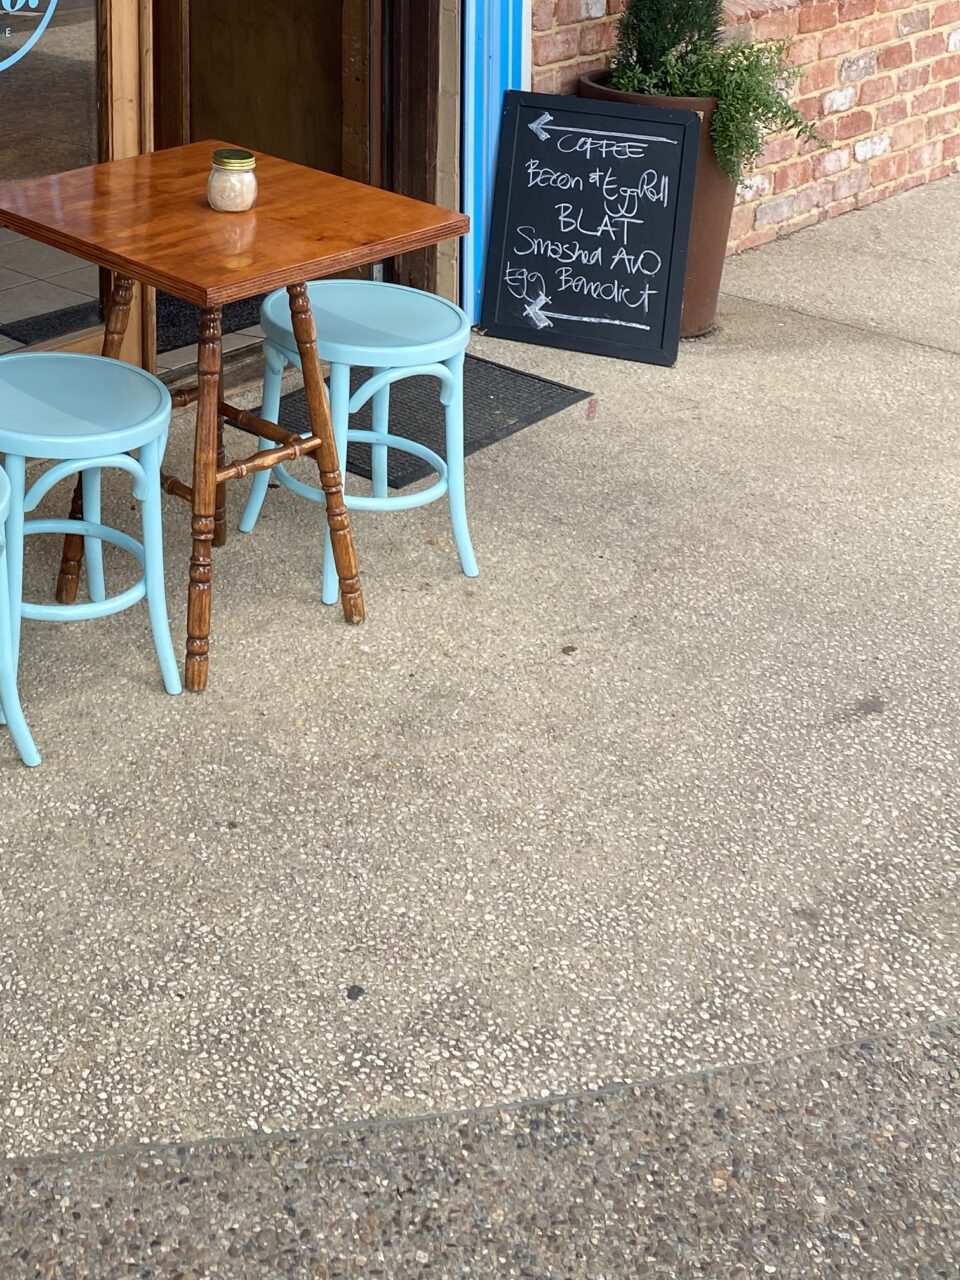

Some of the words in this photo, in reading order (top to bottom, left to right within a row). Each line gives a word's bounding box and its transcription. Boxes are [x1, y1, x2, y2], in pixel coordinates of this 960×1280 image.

[525, 158, 583, 192] Bacon
[602, 166, 640, 218] Egg
[638, 168, 670, 208] Roll
[513, 225, 603, 267] Smashed
[555, 202, 645, 246] BLAT
[554, 266, 659, 313] Benedict
